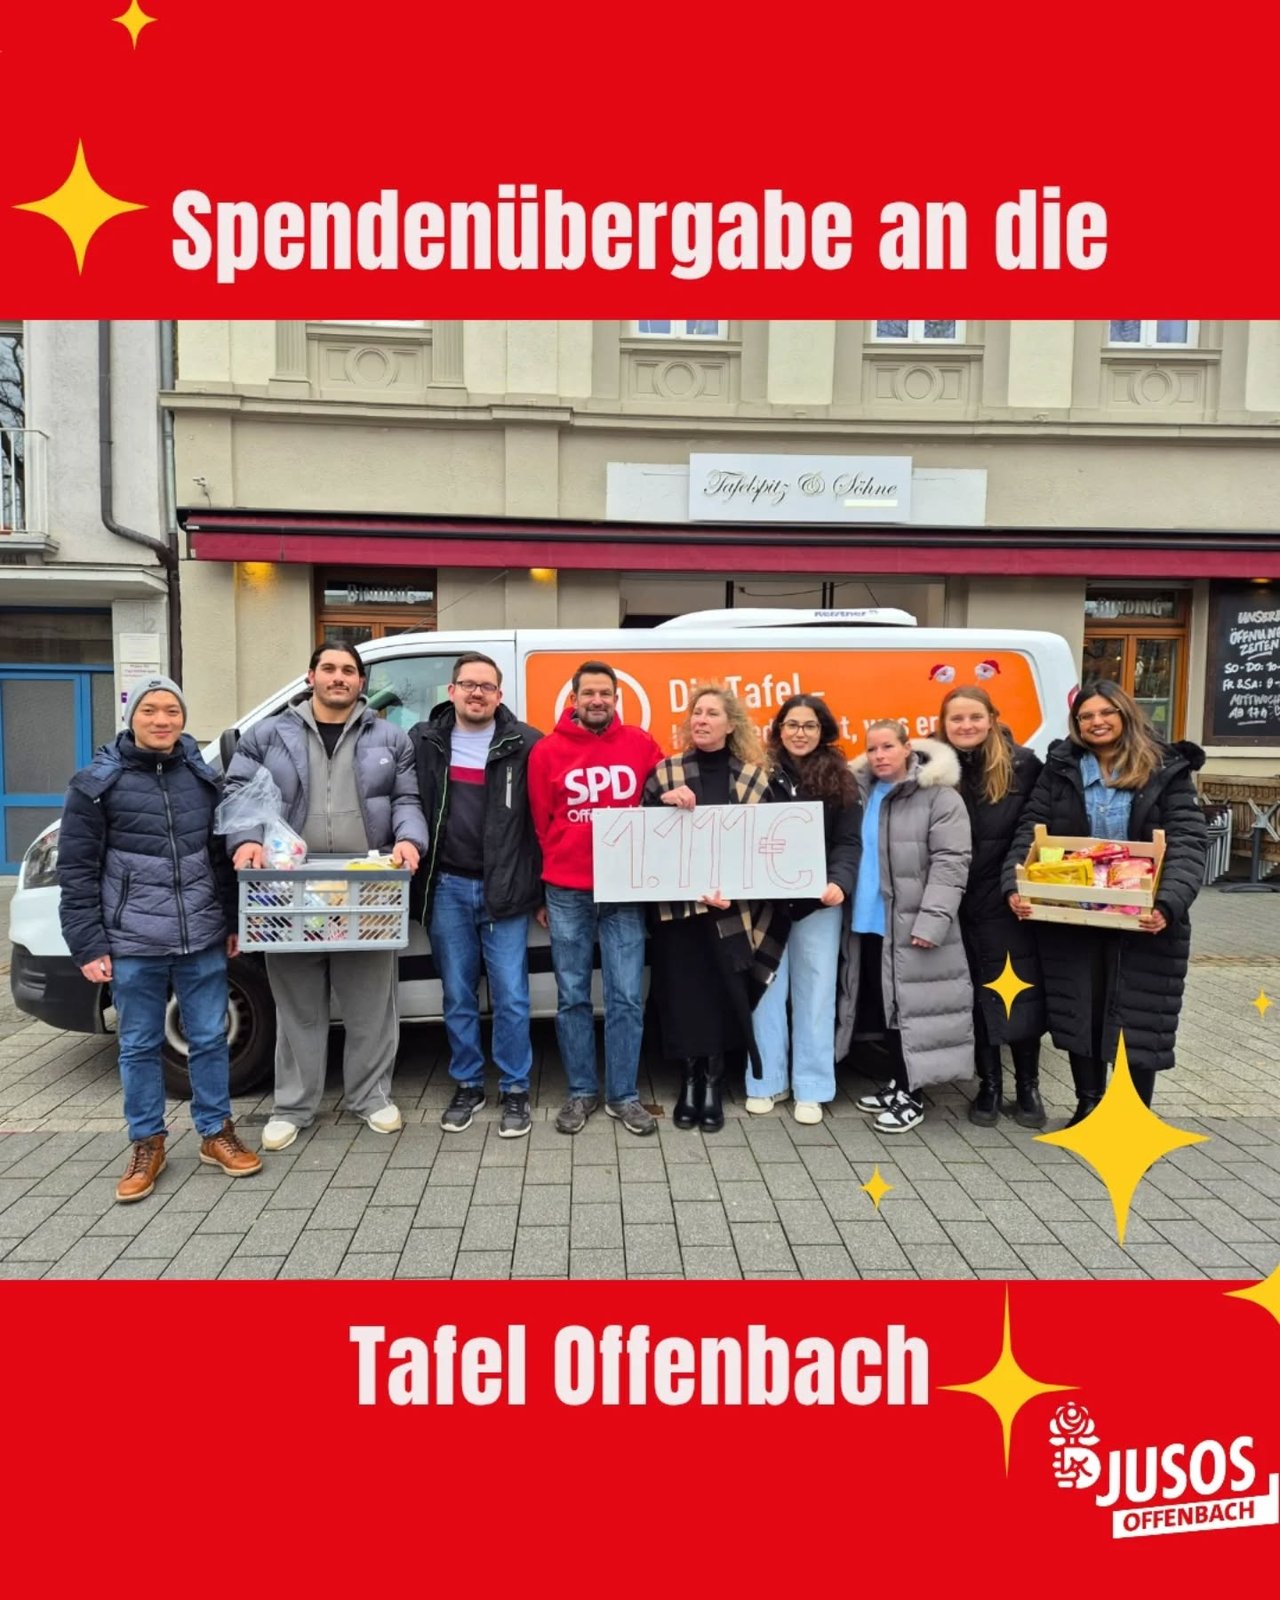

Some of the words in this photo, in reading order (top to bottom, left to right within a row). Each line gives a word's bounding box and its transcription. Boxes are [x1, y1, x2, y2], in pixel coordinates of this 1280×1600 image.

[703, 469, 789, 507] Tafelspitz
[798, 471, 826, 497] &
[833, 471, 897, 500] Söhne
[1240, 639, 1280, 656] ZEITEN
[1224, 662, 1239, 674] SO
[724, 672, 803, 709] Tafel
[564, 764, 637, 806] SPD
